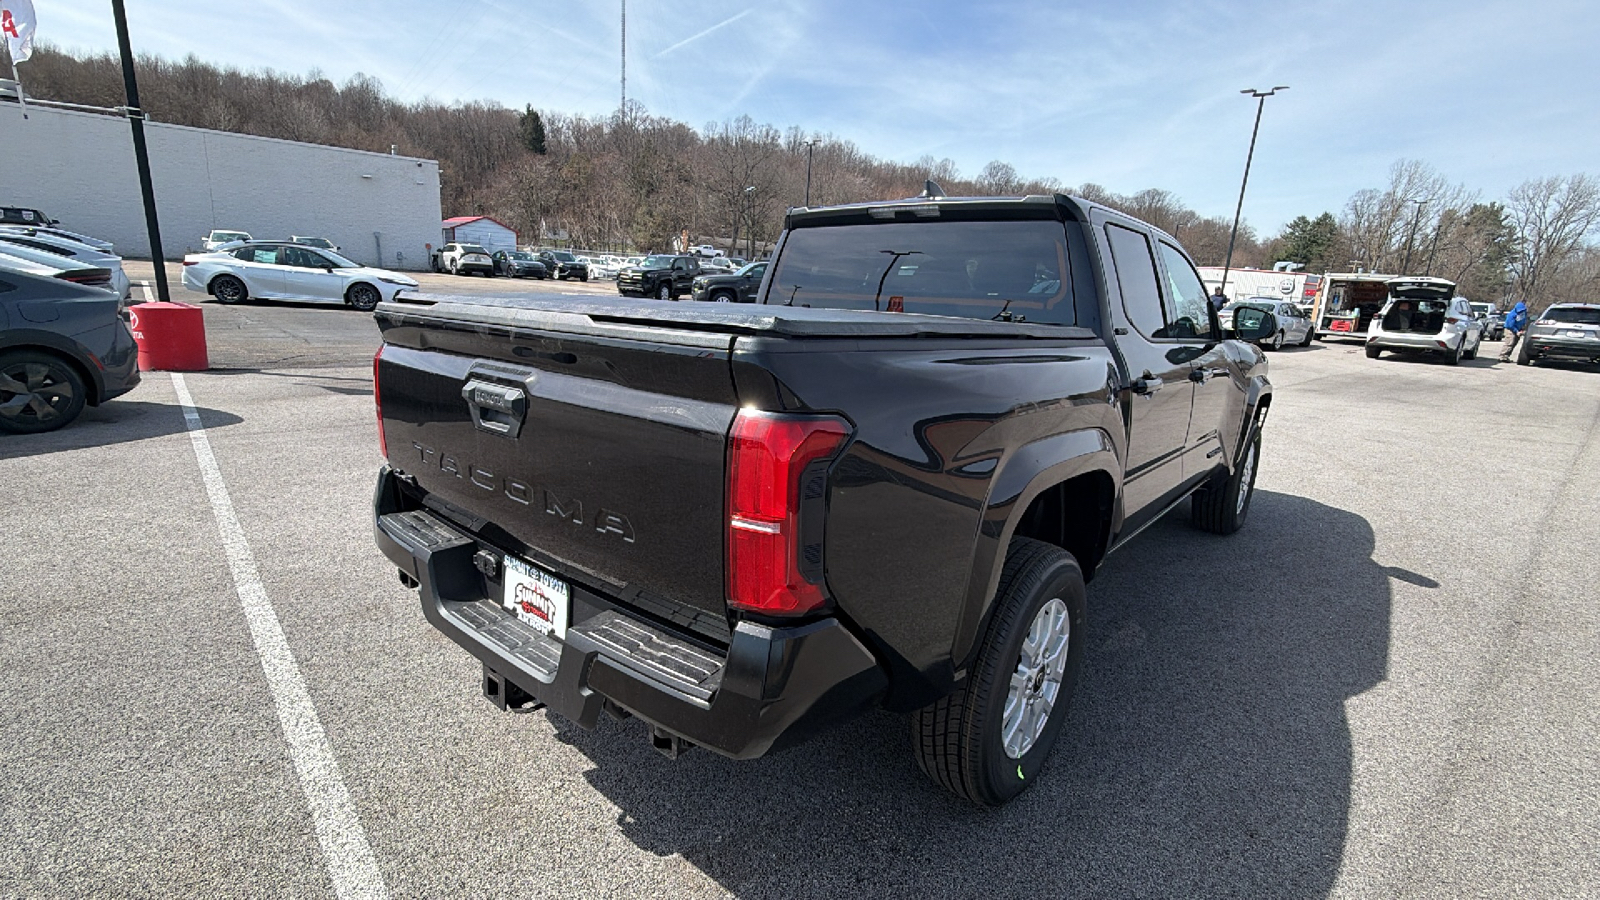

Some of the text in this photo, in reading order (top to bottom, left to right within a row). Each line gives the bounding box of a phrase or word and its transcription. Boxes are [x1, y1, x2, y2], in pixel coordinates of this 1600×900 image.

[412, 440, 636, 543] TACOMA
[504, 554, 568, 597] SUMMIT TOYOTA
[514, 582, 556, 625] SUMMIT
